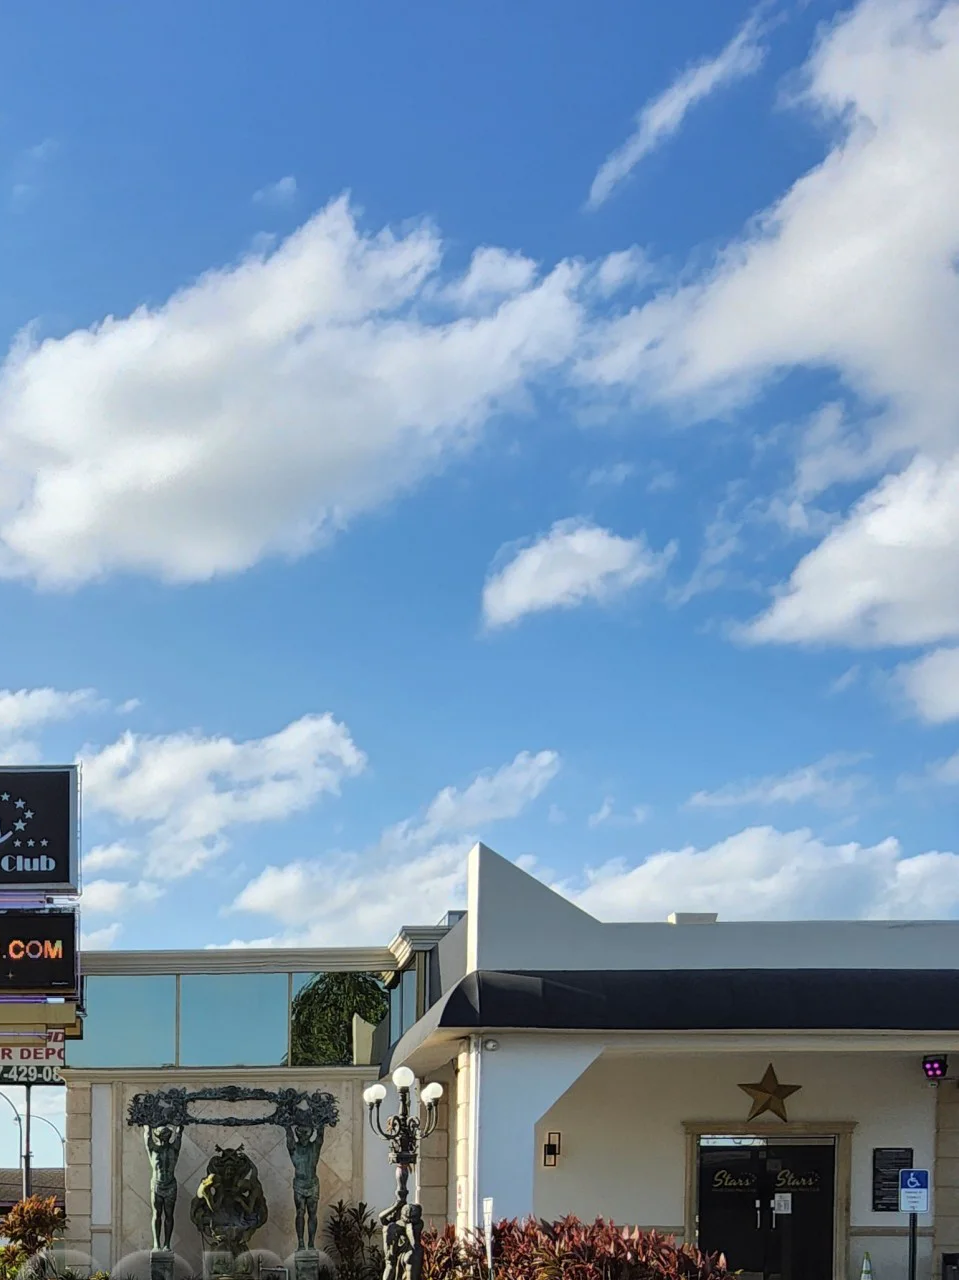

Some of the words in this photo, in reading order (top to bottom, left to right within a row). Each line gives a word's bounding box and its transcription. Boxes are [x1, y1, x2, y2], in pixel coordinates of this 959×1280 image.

[1, 854, 56, 872] Club
[712, 1169, 751, 1187] Stars
[775, 1169, 815, 1187] Stars
